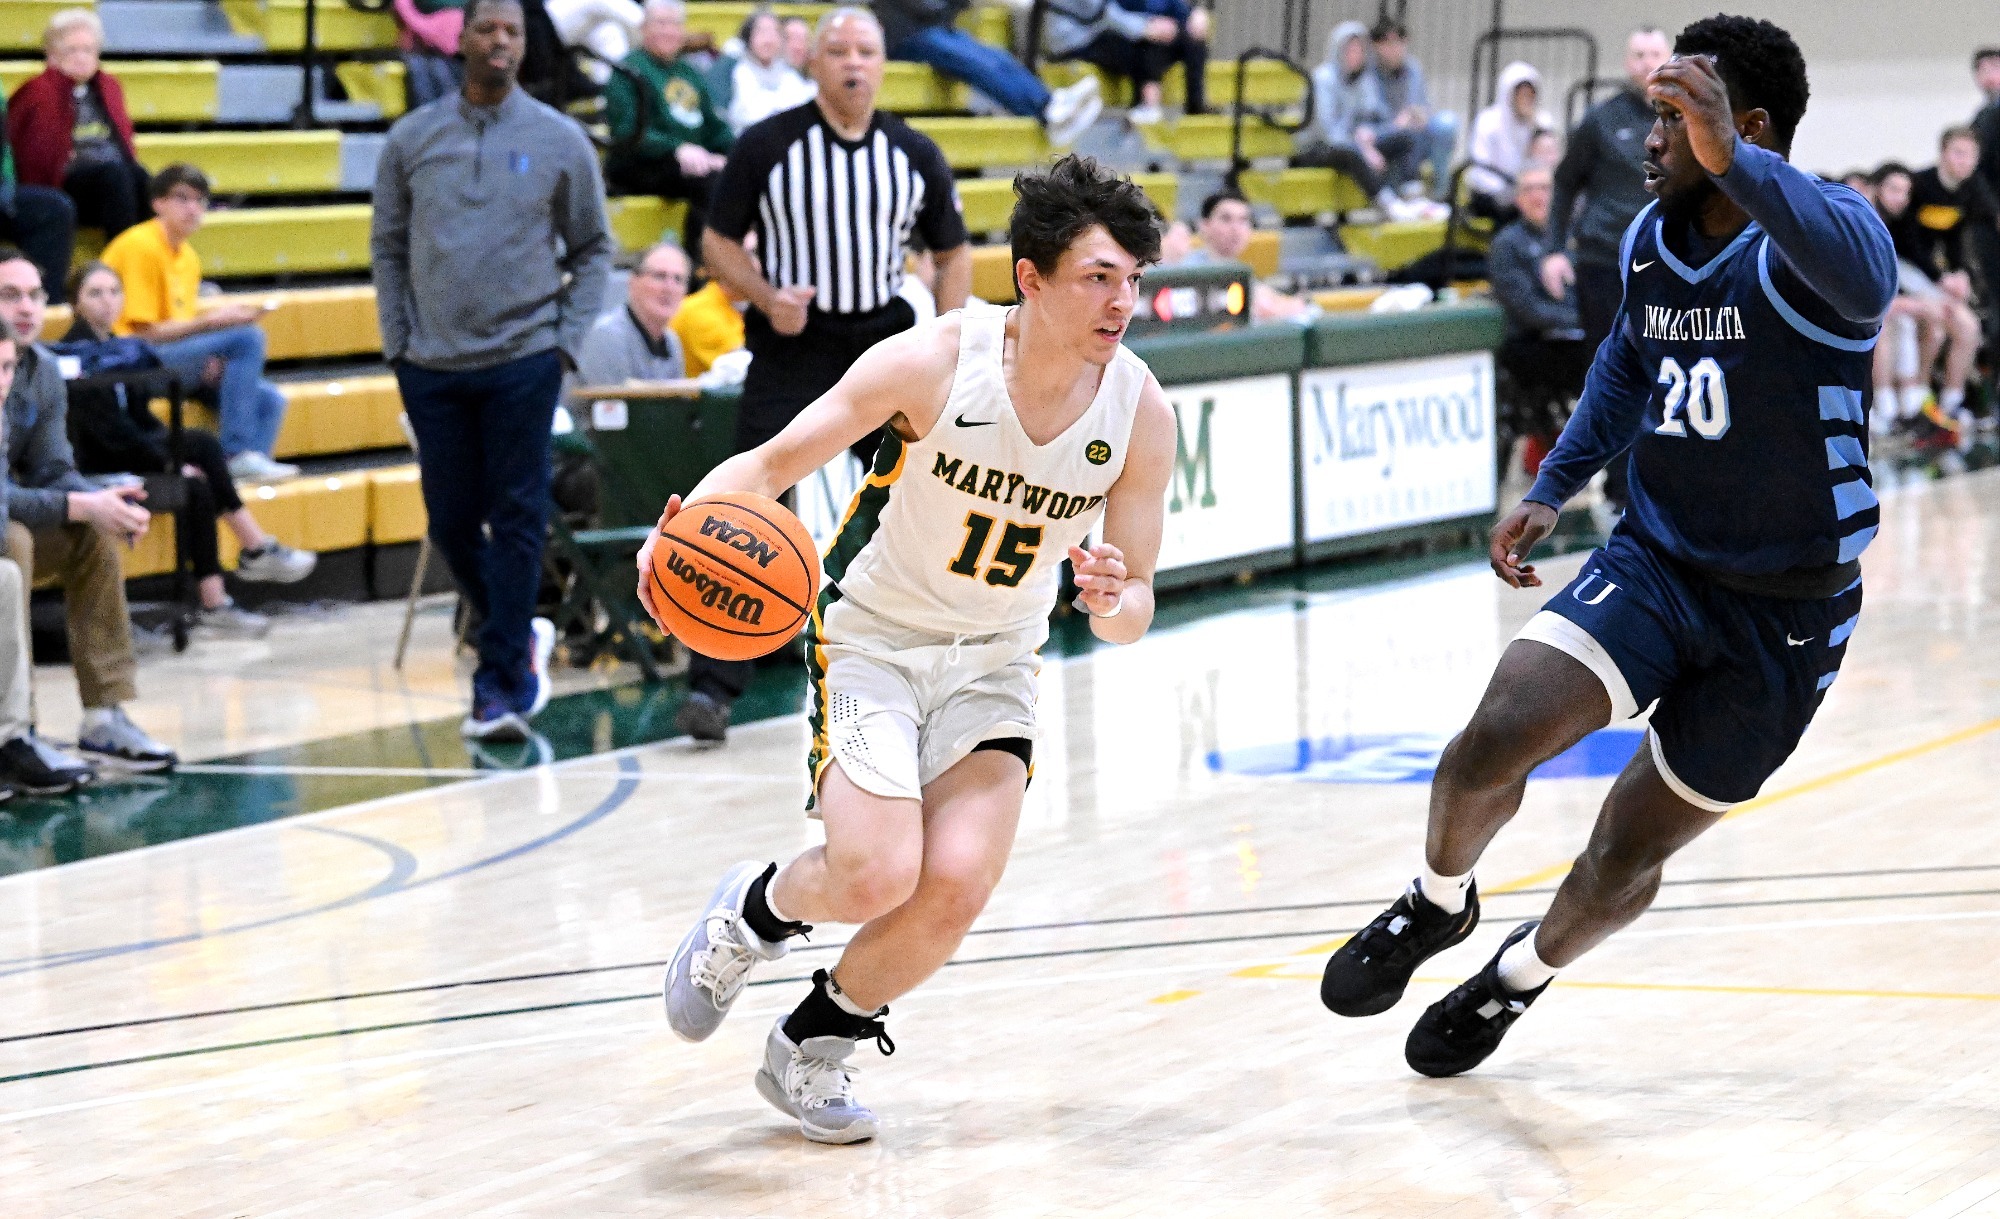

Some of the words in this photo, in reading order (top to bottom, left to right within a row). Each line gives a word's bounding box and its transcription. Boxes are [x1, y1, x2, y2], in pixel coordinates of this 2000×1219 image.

[1643, 304, 1747, 341] IMMACULATA
[1655, 356, 1731, 440] 20
[931, 451, 1104, 520] MARYWOOD
[1088, 444, 1108, 462] 22
[699, 515, 779, 568] NCAA
[946, 509, 1045, 588] 15
[666, 549, 765, 626] Wilson
